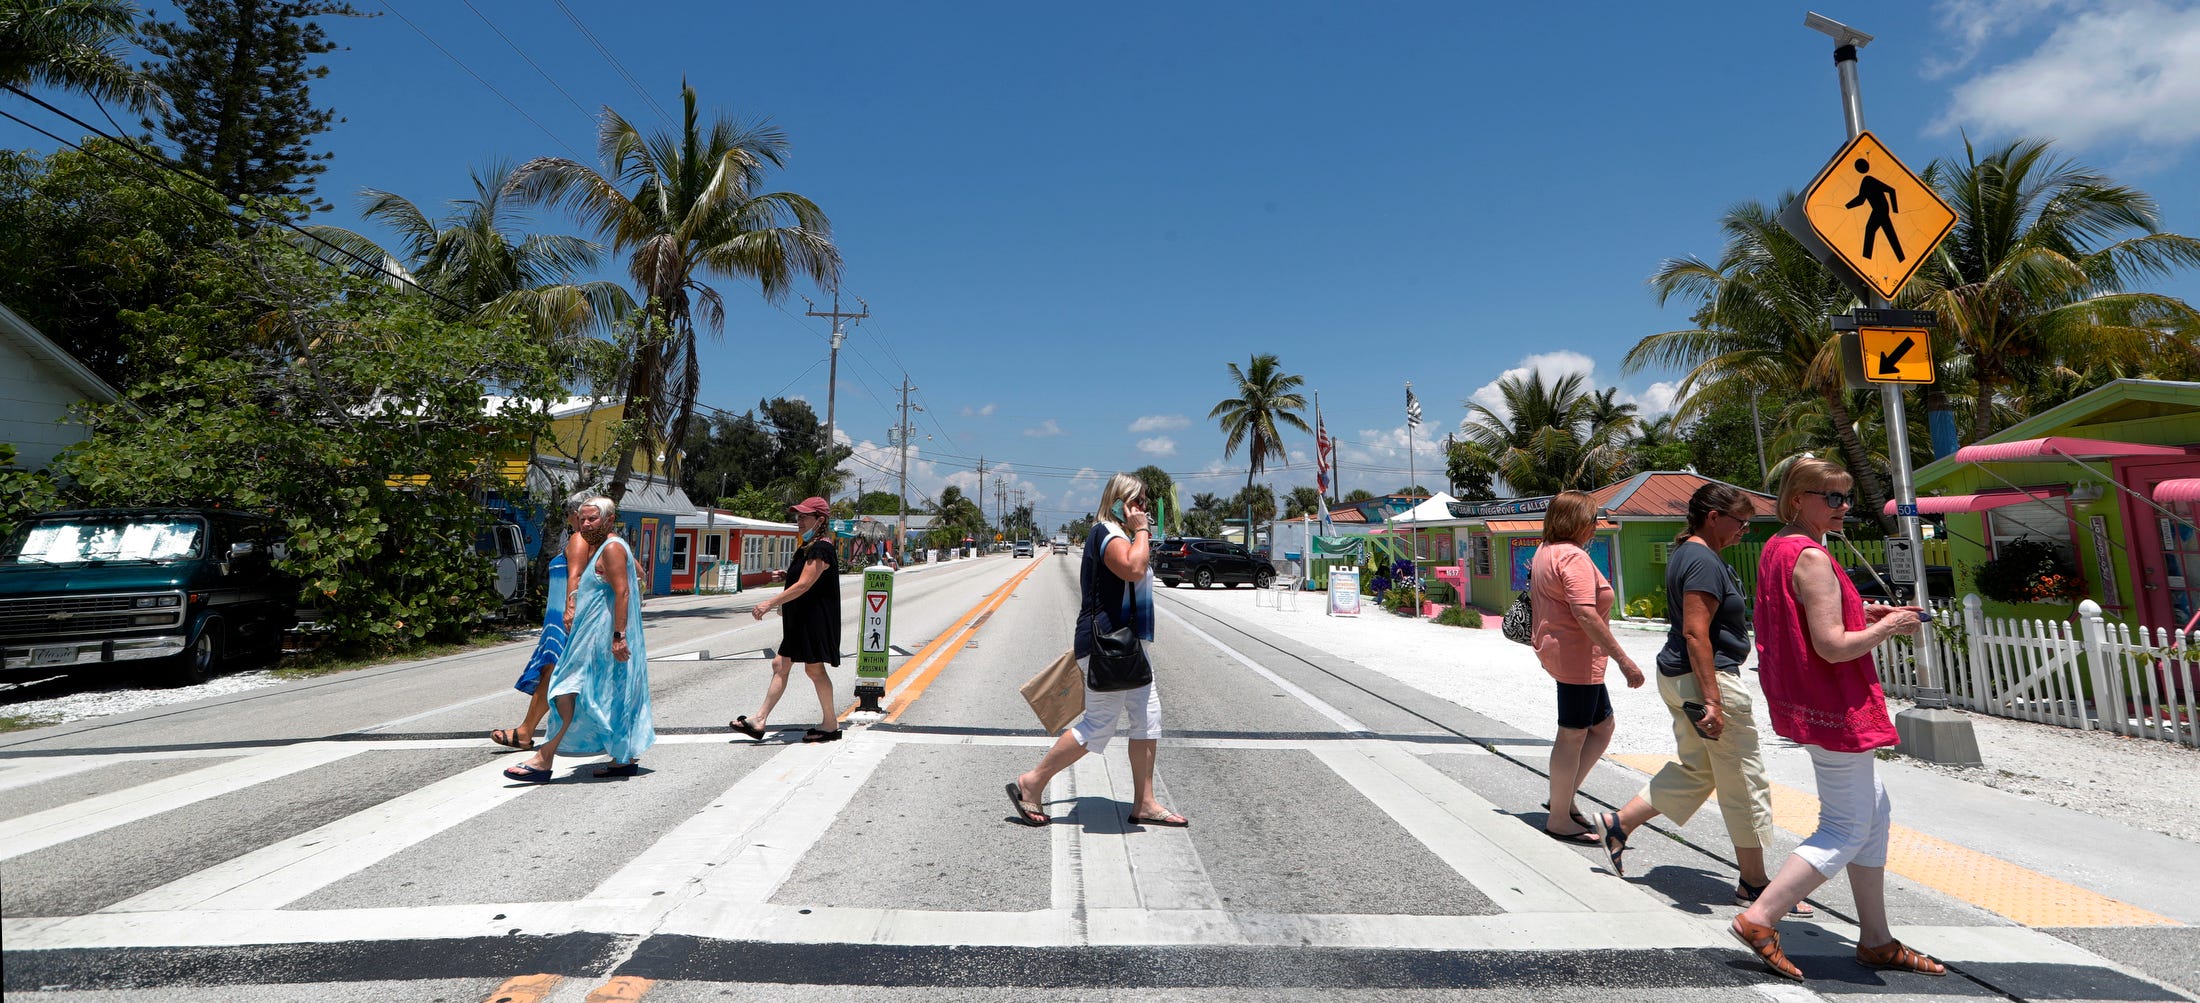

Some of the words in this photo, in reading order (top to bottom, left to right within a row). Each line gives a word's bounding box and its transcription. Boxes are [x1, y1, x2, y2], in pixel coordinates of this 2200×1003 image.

[1477, 506, 1516, 515] LOVEGROVE
[1520, 500, 1550, 512] GALLER
[1512, 538, 1543, 547] GALLER
[870, 617, 881, 625] TO
